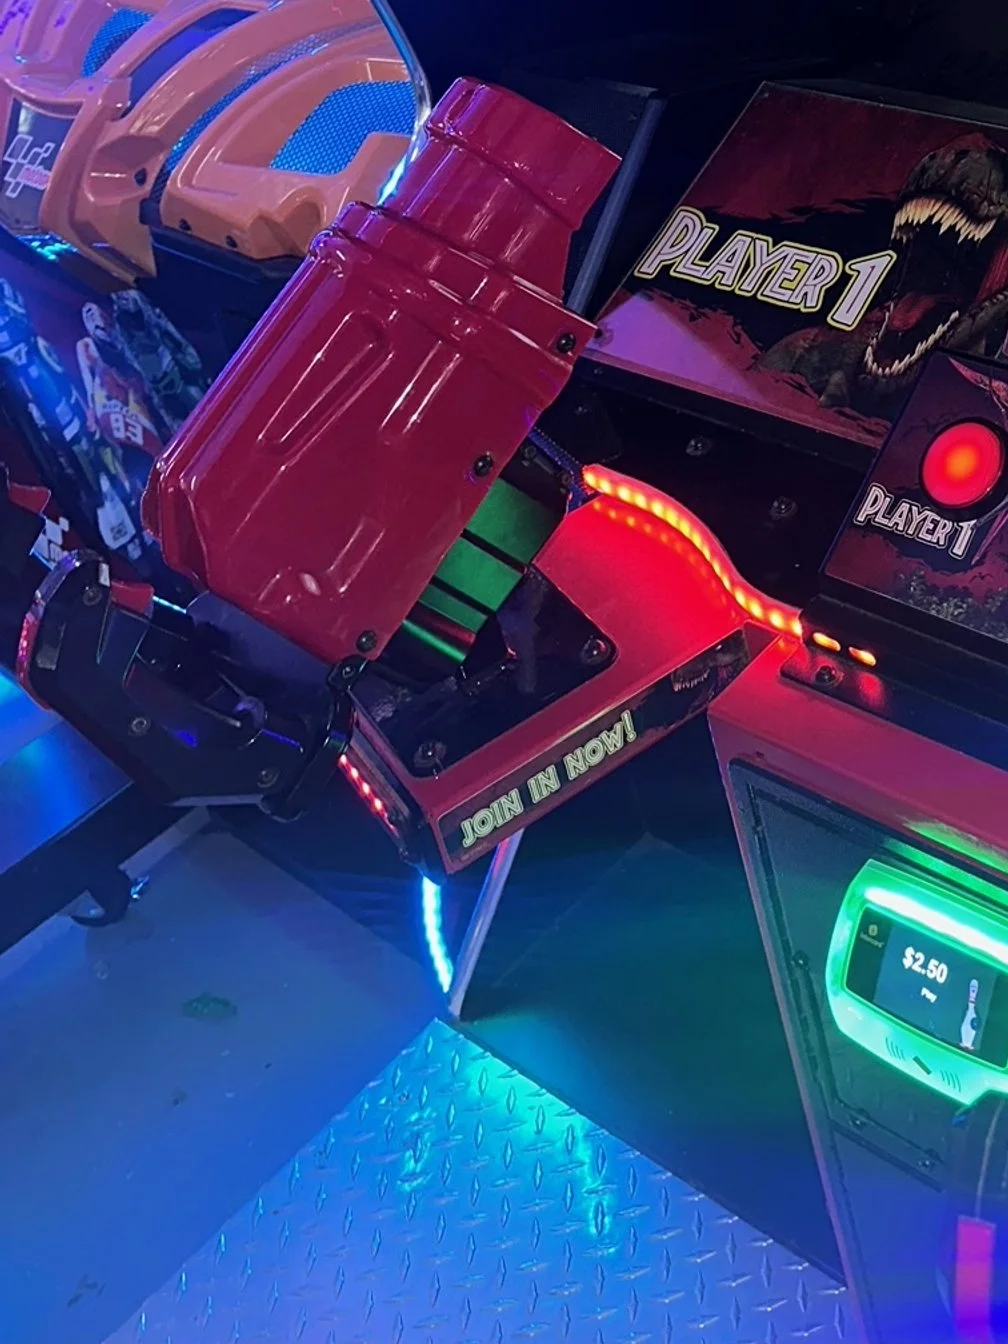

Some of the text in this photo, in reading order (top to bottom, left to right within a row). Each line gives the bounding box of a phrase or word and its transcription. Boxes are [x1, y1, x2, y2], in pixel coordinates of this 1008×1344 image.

[634, 206, 898, 332] PLAYER 1
[853, 482, 978, 559] PLAYER 1
[460, 710, 637, 848] JOIN IN NOW!
[902, 946, 949, 984] $2.50
